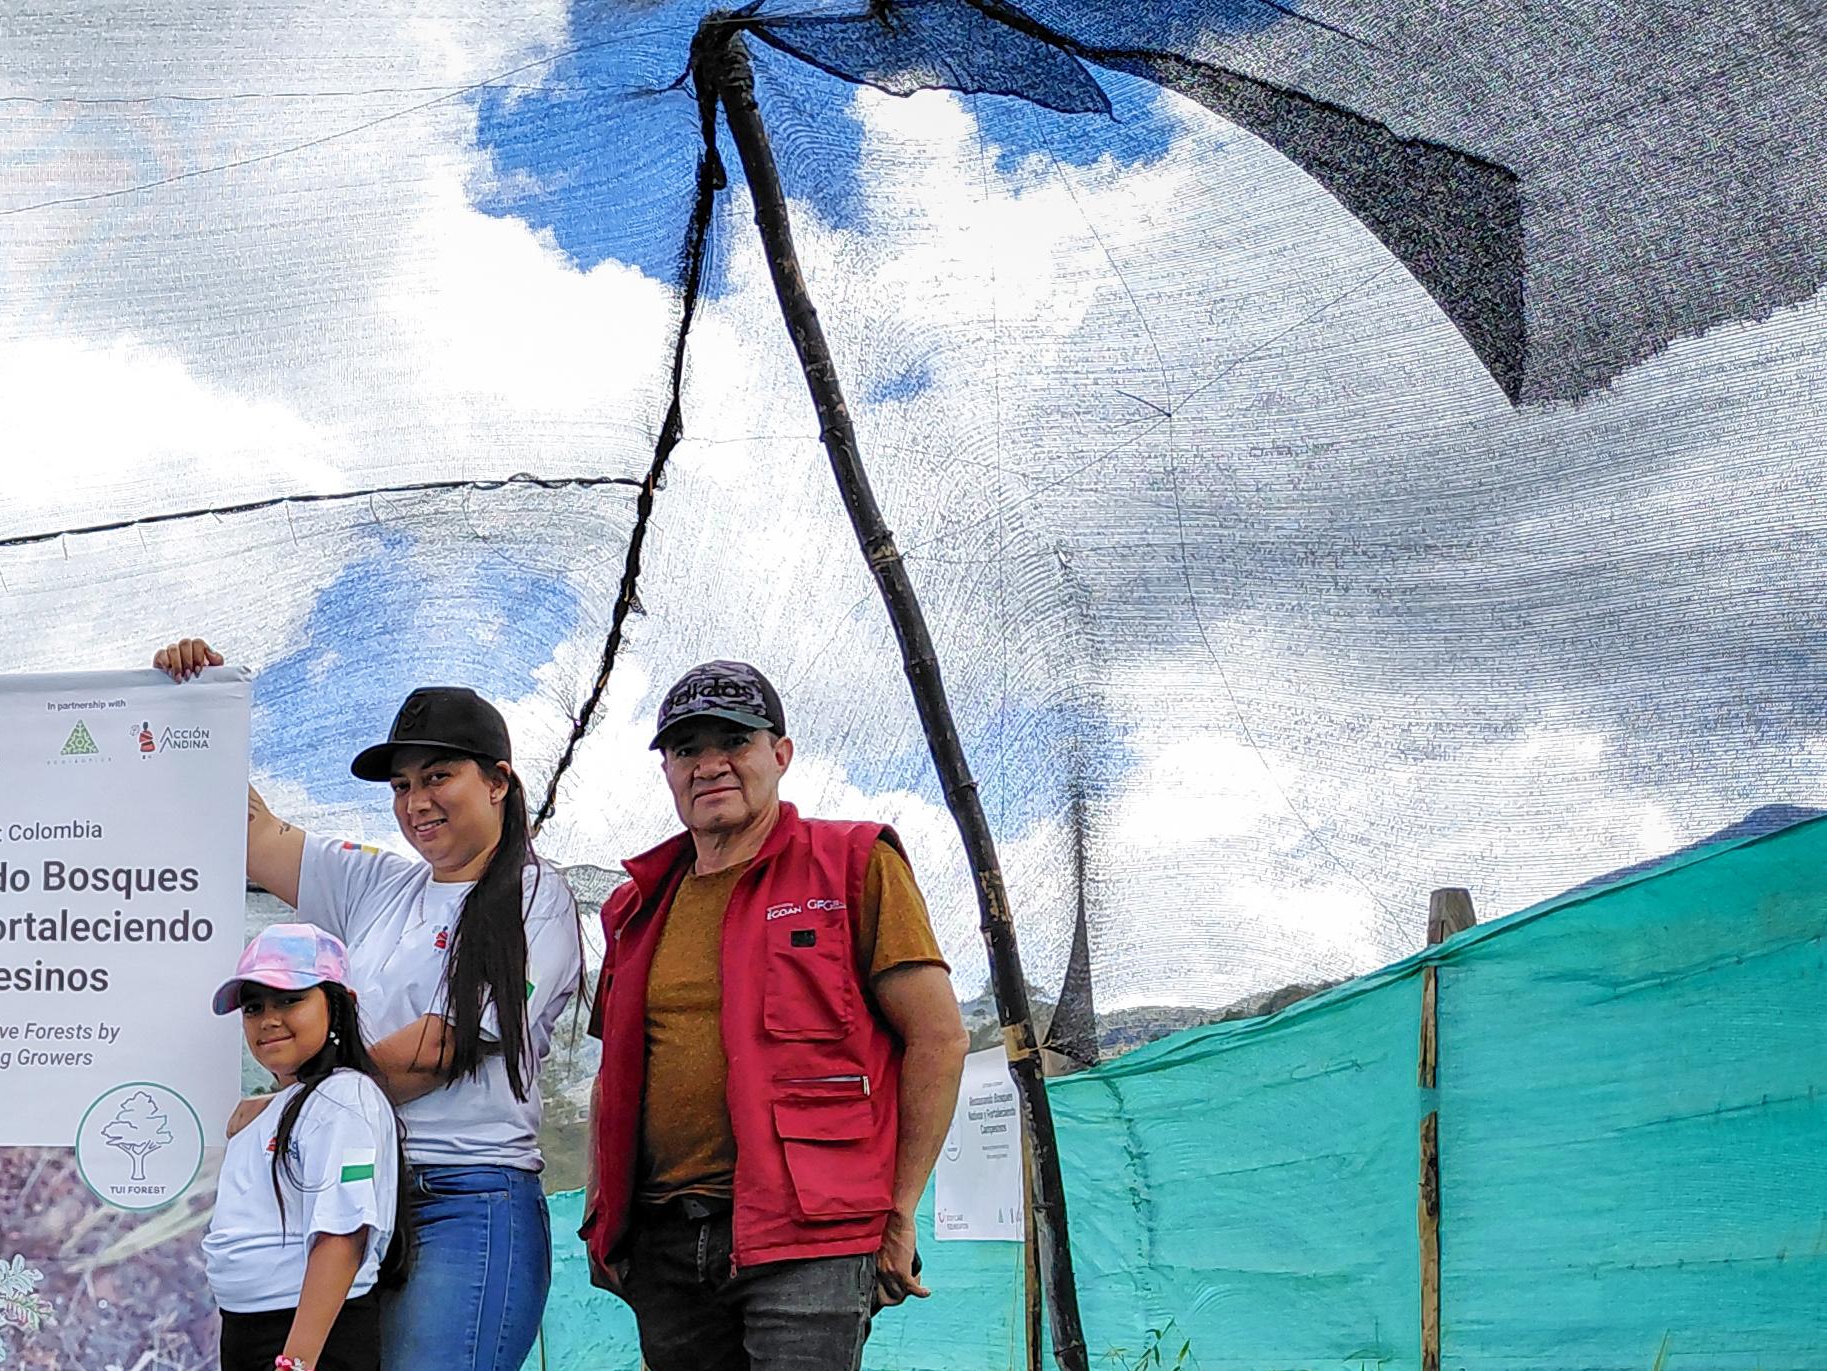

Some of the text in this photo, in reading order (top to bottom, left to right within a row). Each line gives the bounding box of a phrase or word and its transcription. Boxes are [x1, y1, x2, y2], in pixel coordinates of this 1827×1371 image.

[47, 699, 126, 711] In partnership with
[159, 726, 210, 744] ACCIÓN
[159, 736, 210, 753] ANDINA
[8, 820, 103, 842] Colombia
[43, 860, 200, 900] Bosques
[24, 1022, 94, 1040] Forests
[98, 1022, 121, 1044] by
[17, 1048, 93, 1066] Growers
[110, 1186, 166, 1194] TUI FOREST
